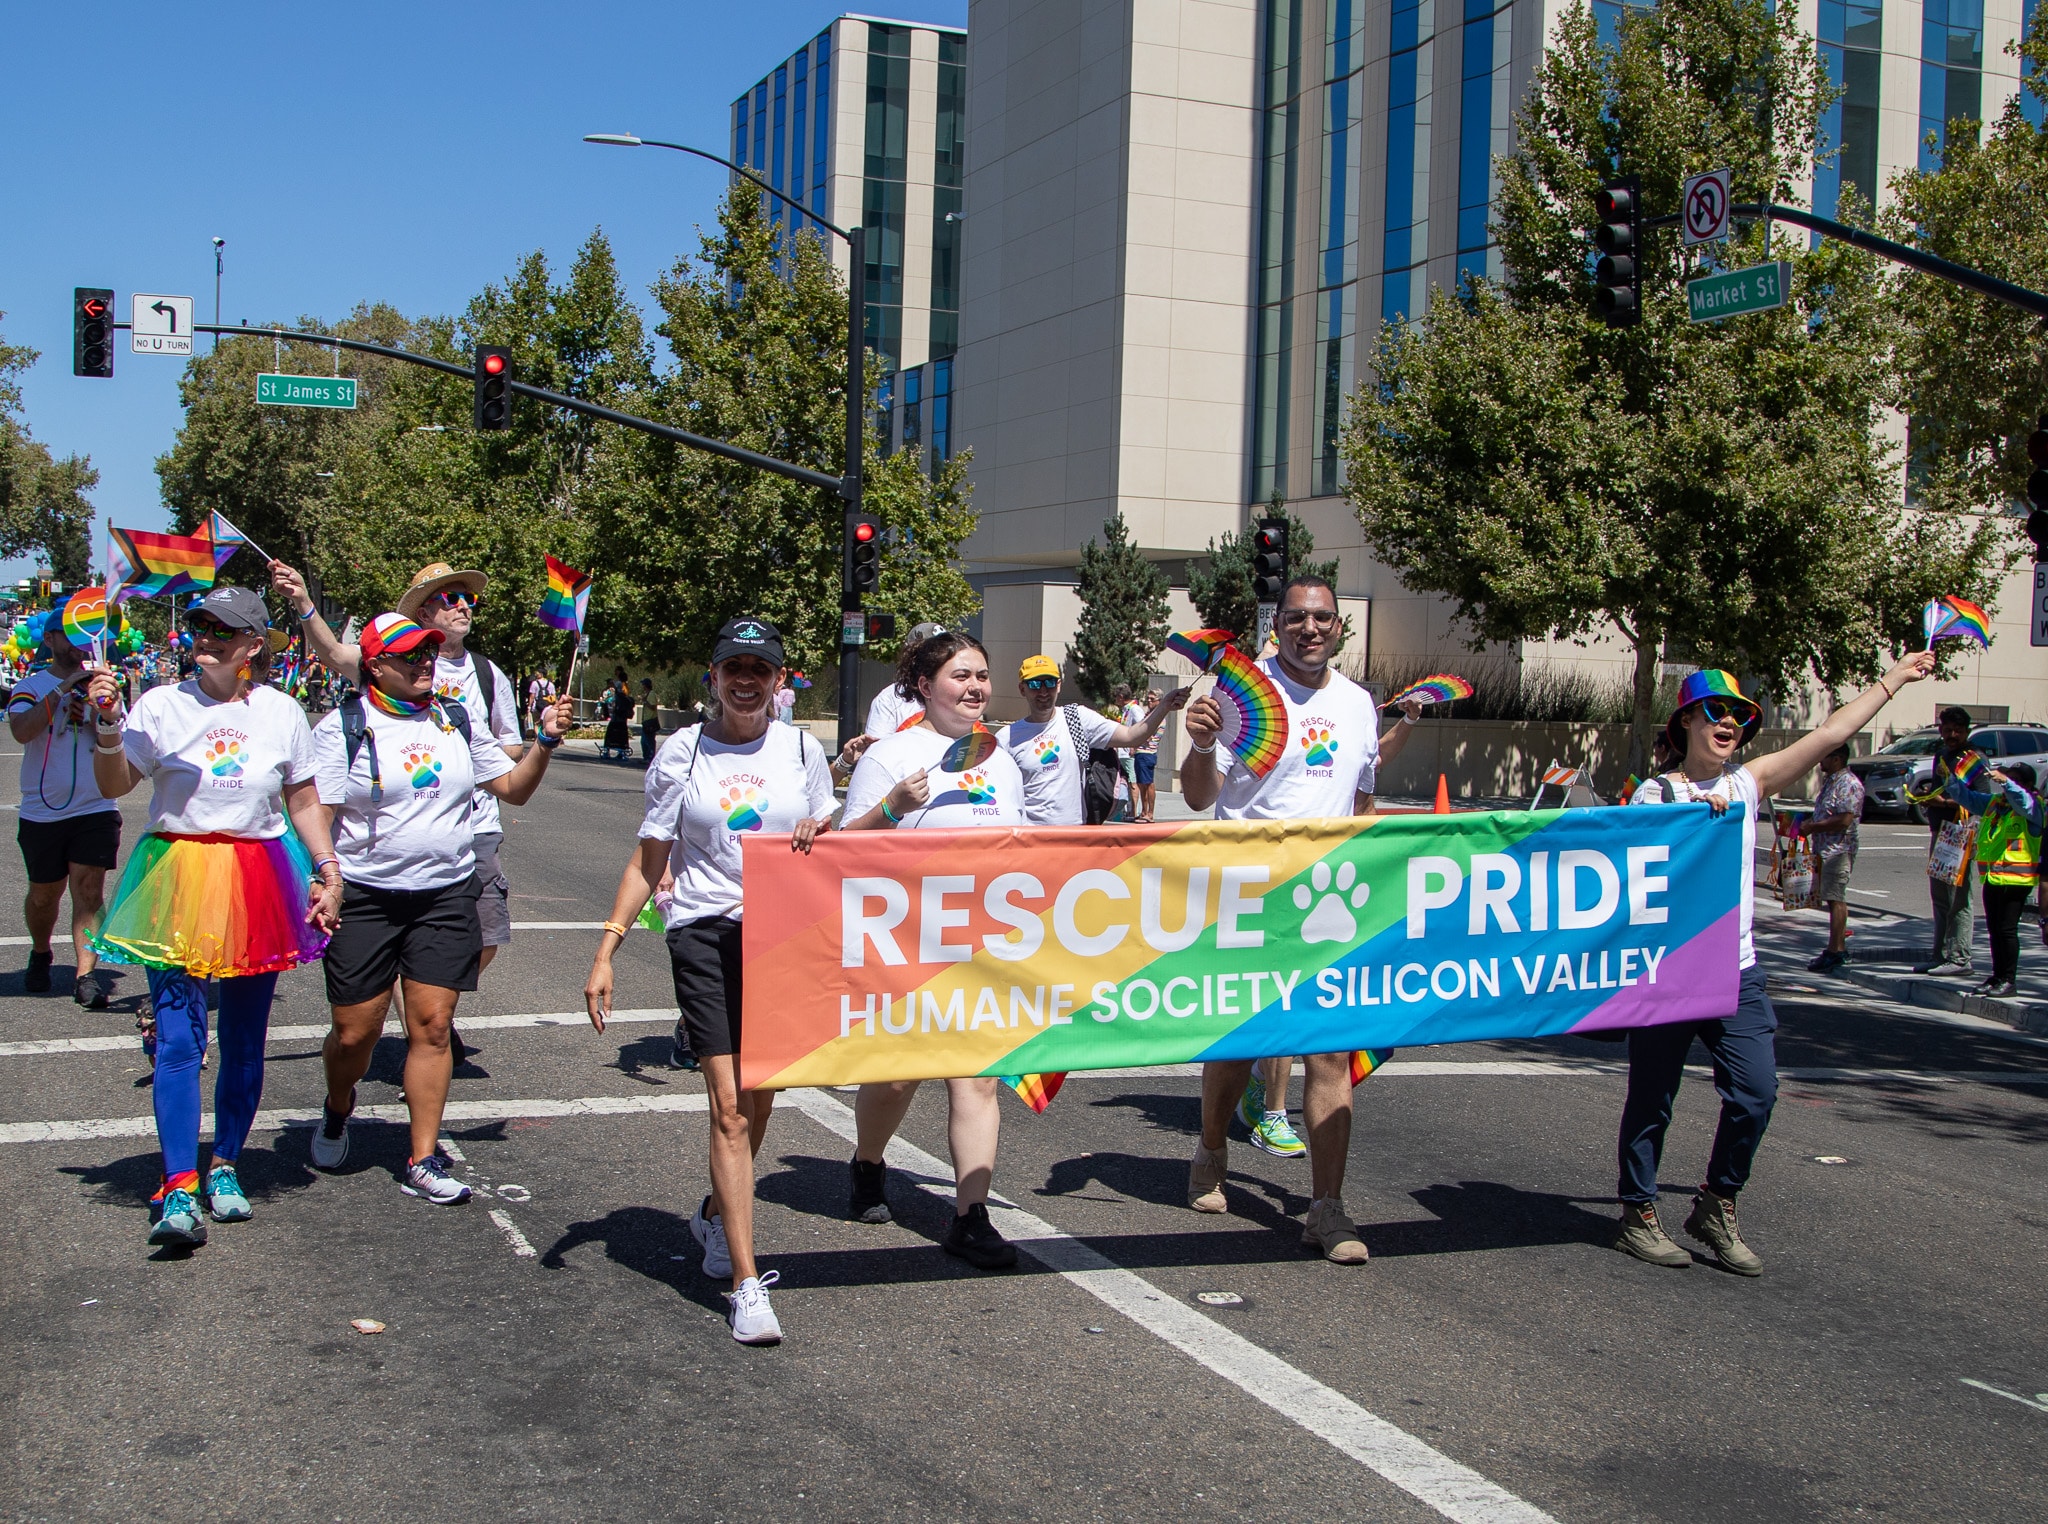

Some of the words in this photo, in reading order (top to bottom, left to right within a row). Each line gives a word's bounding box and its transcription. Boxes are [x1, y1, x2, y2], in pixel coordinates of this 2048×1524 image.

[1693, 281, 1747, 311] Market
[1756, 275, 1775, 298] St
[136, 339, 149, 348] NO
[153, 339, 162, 349] U
[167, 341, 190, 350] TURN
[261, 382, 277, 397] St
[283, 383, 331, 400] James
[336, 386, 352, 401] St
[1300, 716, 1336, 731] RESCUE
[206, 728, 249, 743] RESCUE
[400, 742, 437, 755] RESCUE
[1042, 763, 1060, 772] PRIDE
[1306, 769, 1333, 778] PRIDE
[212, 779, 244, 789] PRIDE
[719, 773, 766, 789] RESCUE
[414, 790, 440, 800] PRIDE
[972, 807, 1000, 816] PRIDE
[841, 865, 1270, 968] RESCUE
[1406, 845, 1669, 940] PRIDE
[840, 983, 1075, 1037] HUMANE
[1090, 969, 1302, 1023] SOCIETY
[1316, 957, 1500, 1009] SILICON
[1512, 946, 1667, 995] VALLEY
